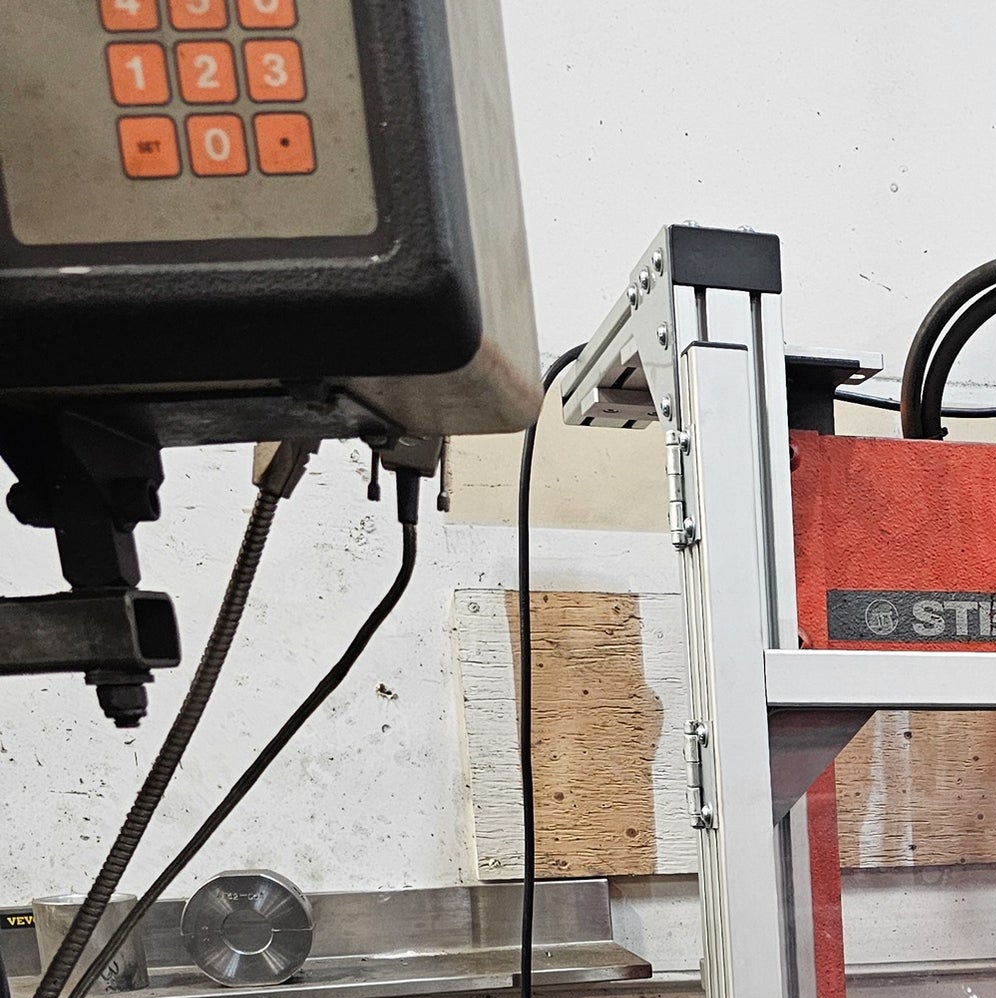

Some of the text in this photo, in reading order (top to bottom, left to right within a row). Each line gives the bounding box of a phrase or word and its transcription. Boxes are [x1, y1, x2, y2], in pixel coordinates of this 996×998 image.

[126, 53, 288, 90] 1 2 3
[204, 128, 231, 161] 0
[7, 915, 35, 926] VEV
